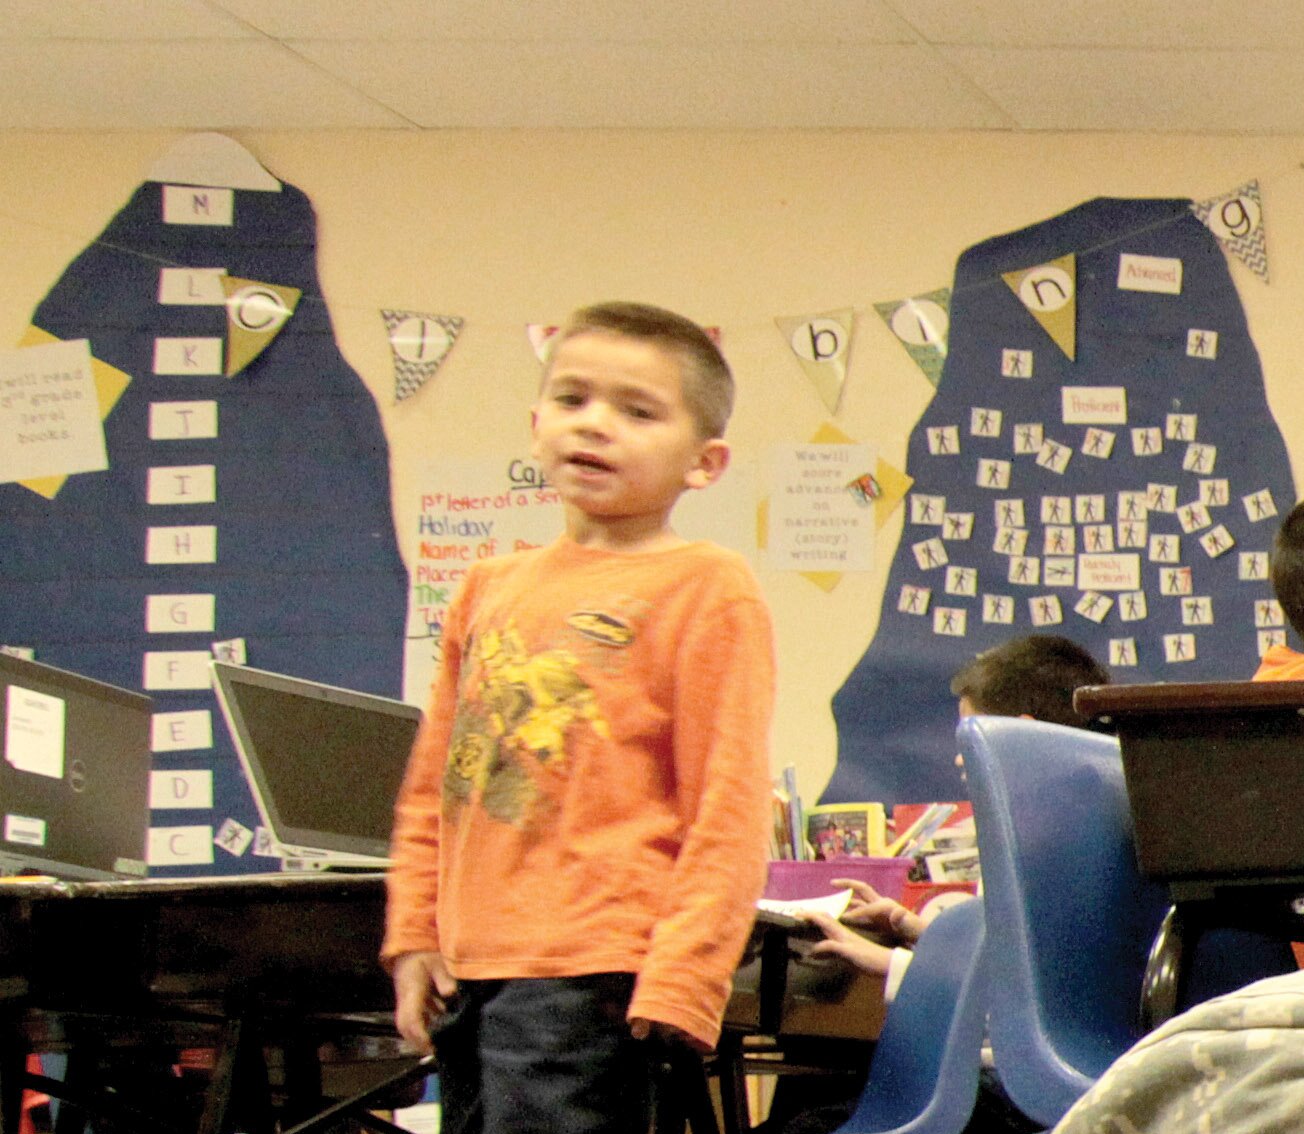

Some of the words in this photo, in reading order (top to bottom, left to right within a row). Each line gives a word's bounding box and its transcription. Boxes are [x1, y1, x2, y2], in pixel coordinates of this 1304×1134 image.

[186, 271, 202, 297] L
[183, 345, 198, 368] K
[174, 532, 191, 556] H
[170, 602, 188, 625] G
[167, 660, 179, 682] F
[169, 720, 186, 742] E
[172, 777, 189, 799] D
[169, 834, 189, 856] C
